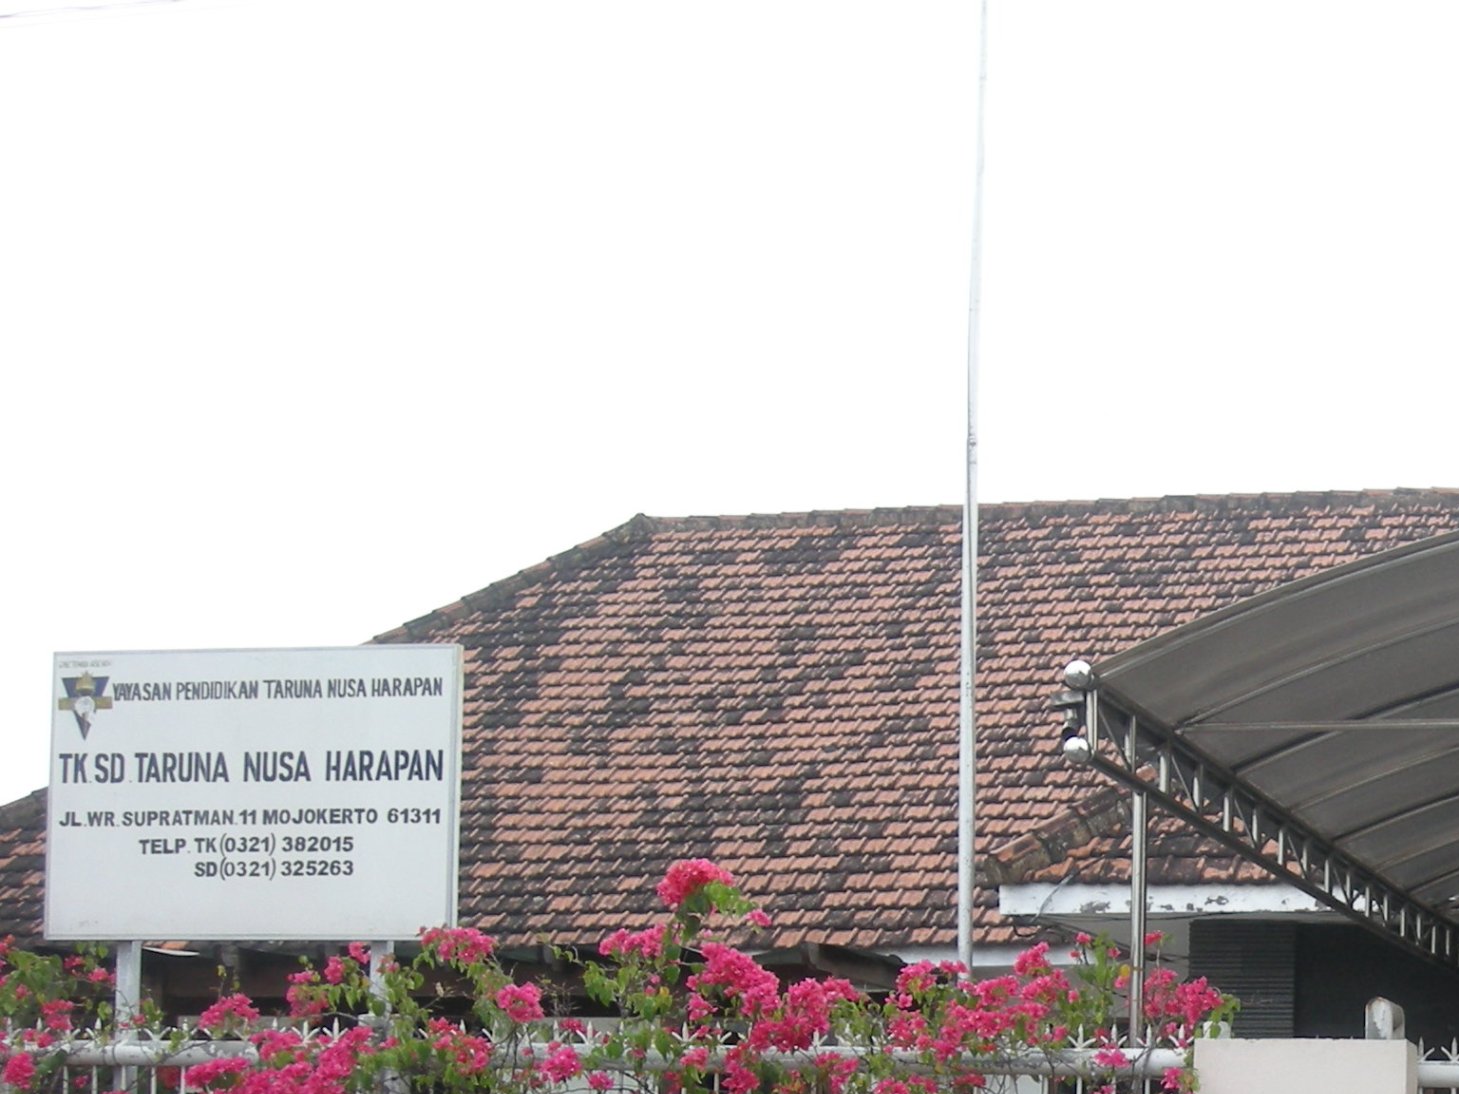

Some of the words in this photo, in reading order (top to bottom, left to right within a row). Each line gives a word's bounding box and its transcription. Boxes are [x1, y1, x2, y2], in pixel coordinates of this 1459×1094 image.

[112, 681, 172, 702] YAYASAN
[176, 680, 259, 701] PENDIDIKAN
[263, 678, 323, 700] TARUNA
[327, 677, 367, 699] NUSA
[371, 677, 443, 698] HARAPAN
[243, 750, 312, 783] NUSA
[325, 748, 444, 782] HARAPAN
[262, 807, 379, 826] MOJOKERTO
[386, 807, 442, 825] 61311
[281, 836, 354, 854] 382015
[280, 860, 355, 878] 325263
